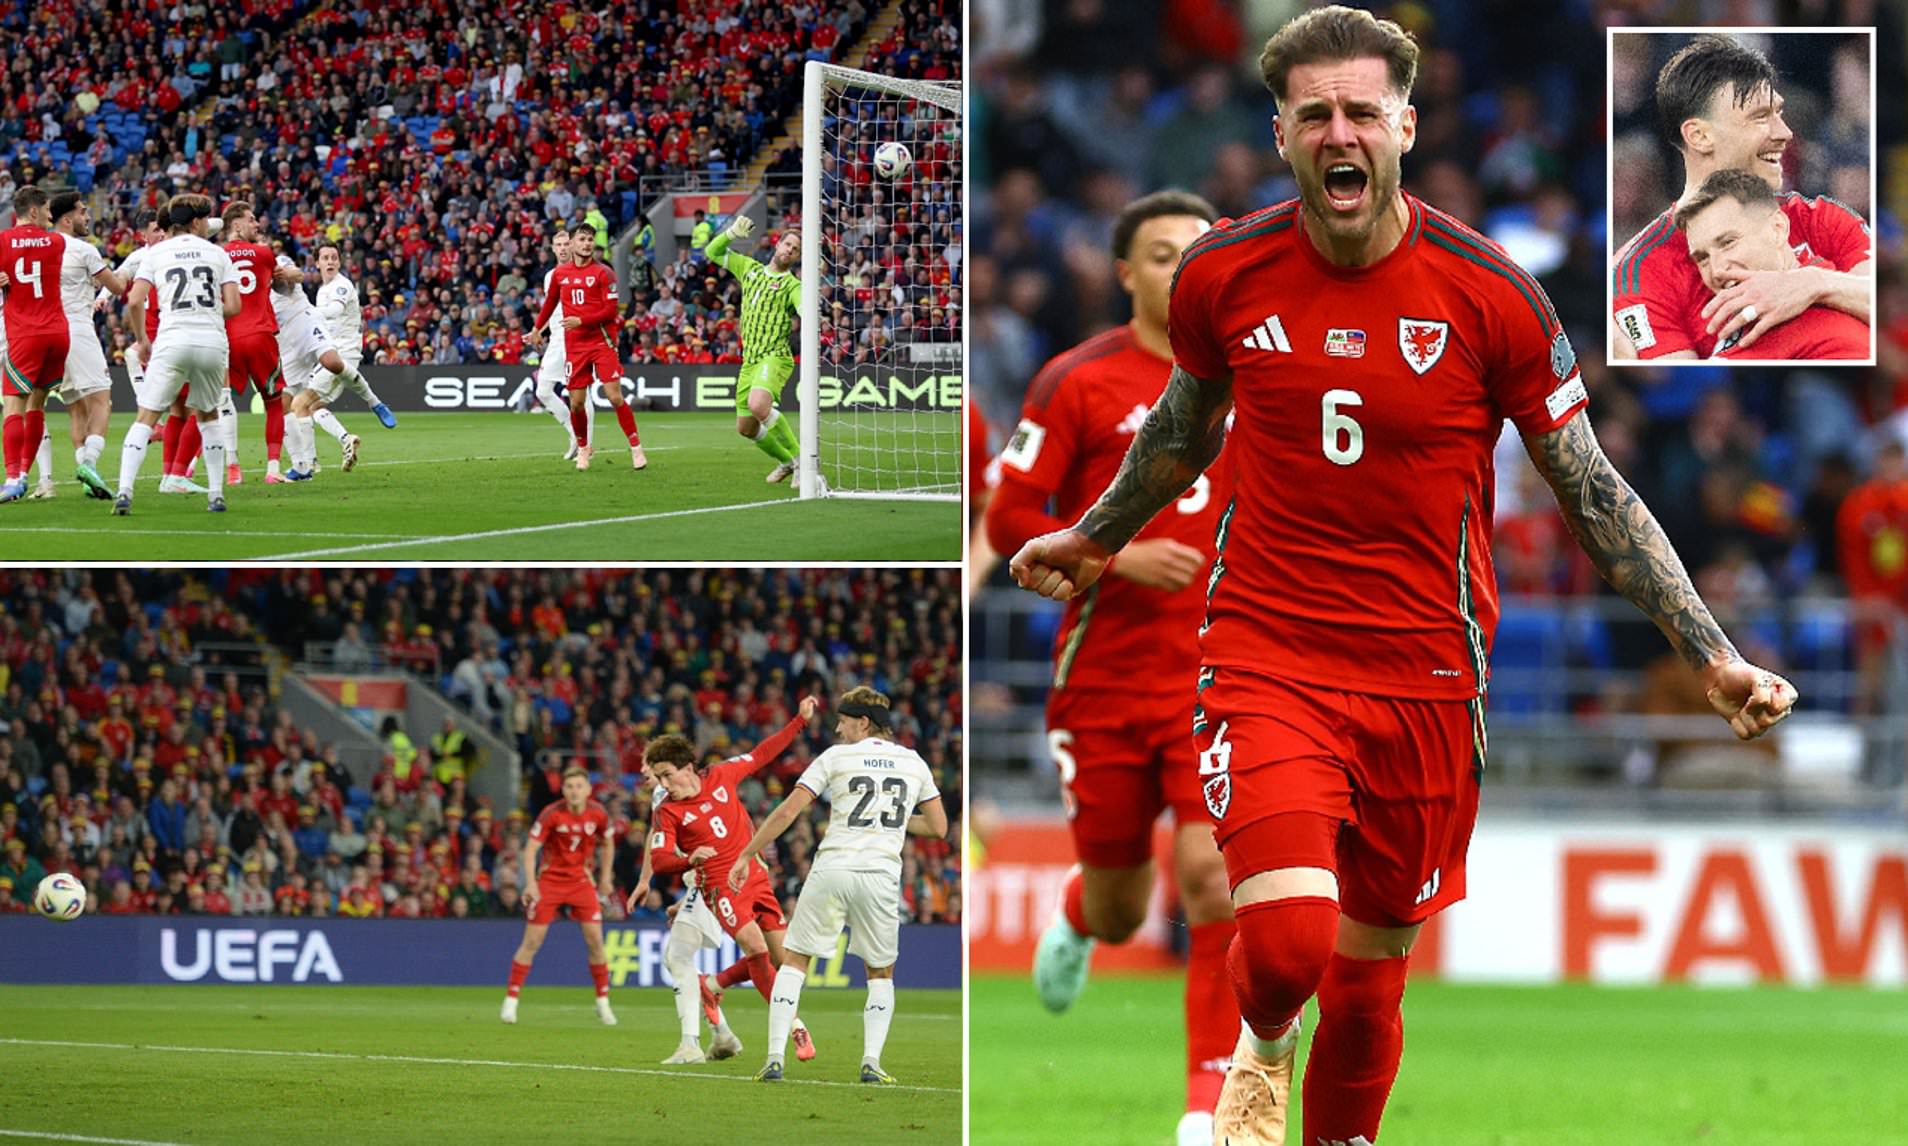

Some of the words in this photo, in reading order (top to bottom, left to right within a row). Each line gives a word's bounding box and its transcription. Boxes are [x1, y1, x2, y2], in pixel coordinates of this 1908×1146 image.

[12, 236, 52, 248] B.DAVIES
[227, 249, 256, 257] ODON
[15, 256, 43, 298] 4
[165, 266, 216, 311] 23
[232, 259, 257, 294] 6
[571, 288, 584, 305] 10
[424, 376, 681, 408] SEACH
[1322, 389, 1364, 466] 6
[863, 759, 896, 769] HOFER
[1198, 721, 1232, 774] 6
[847, 775, 908, 829] 23
[709, 815, 728, 839] 8
[569, 835, 581, 853] 7
[718, 896, 734, 918] 8
[1560, 849, 1908, 983] FAW
[160, 928, 344, 983] UEFA
